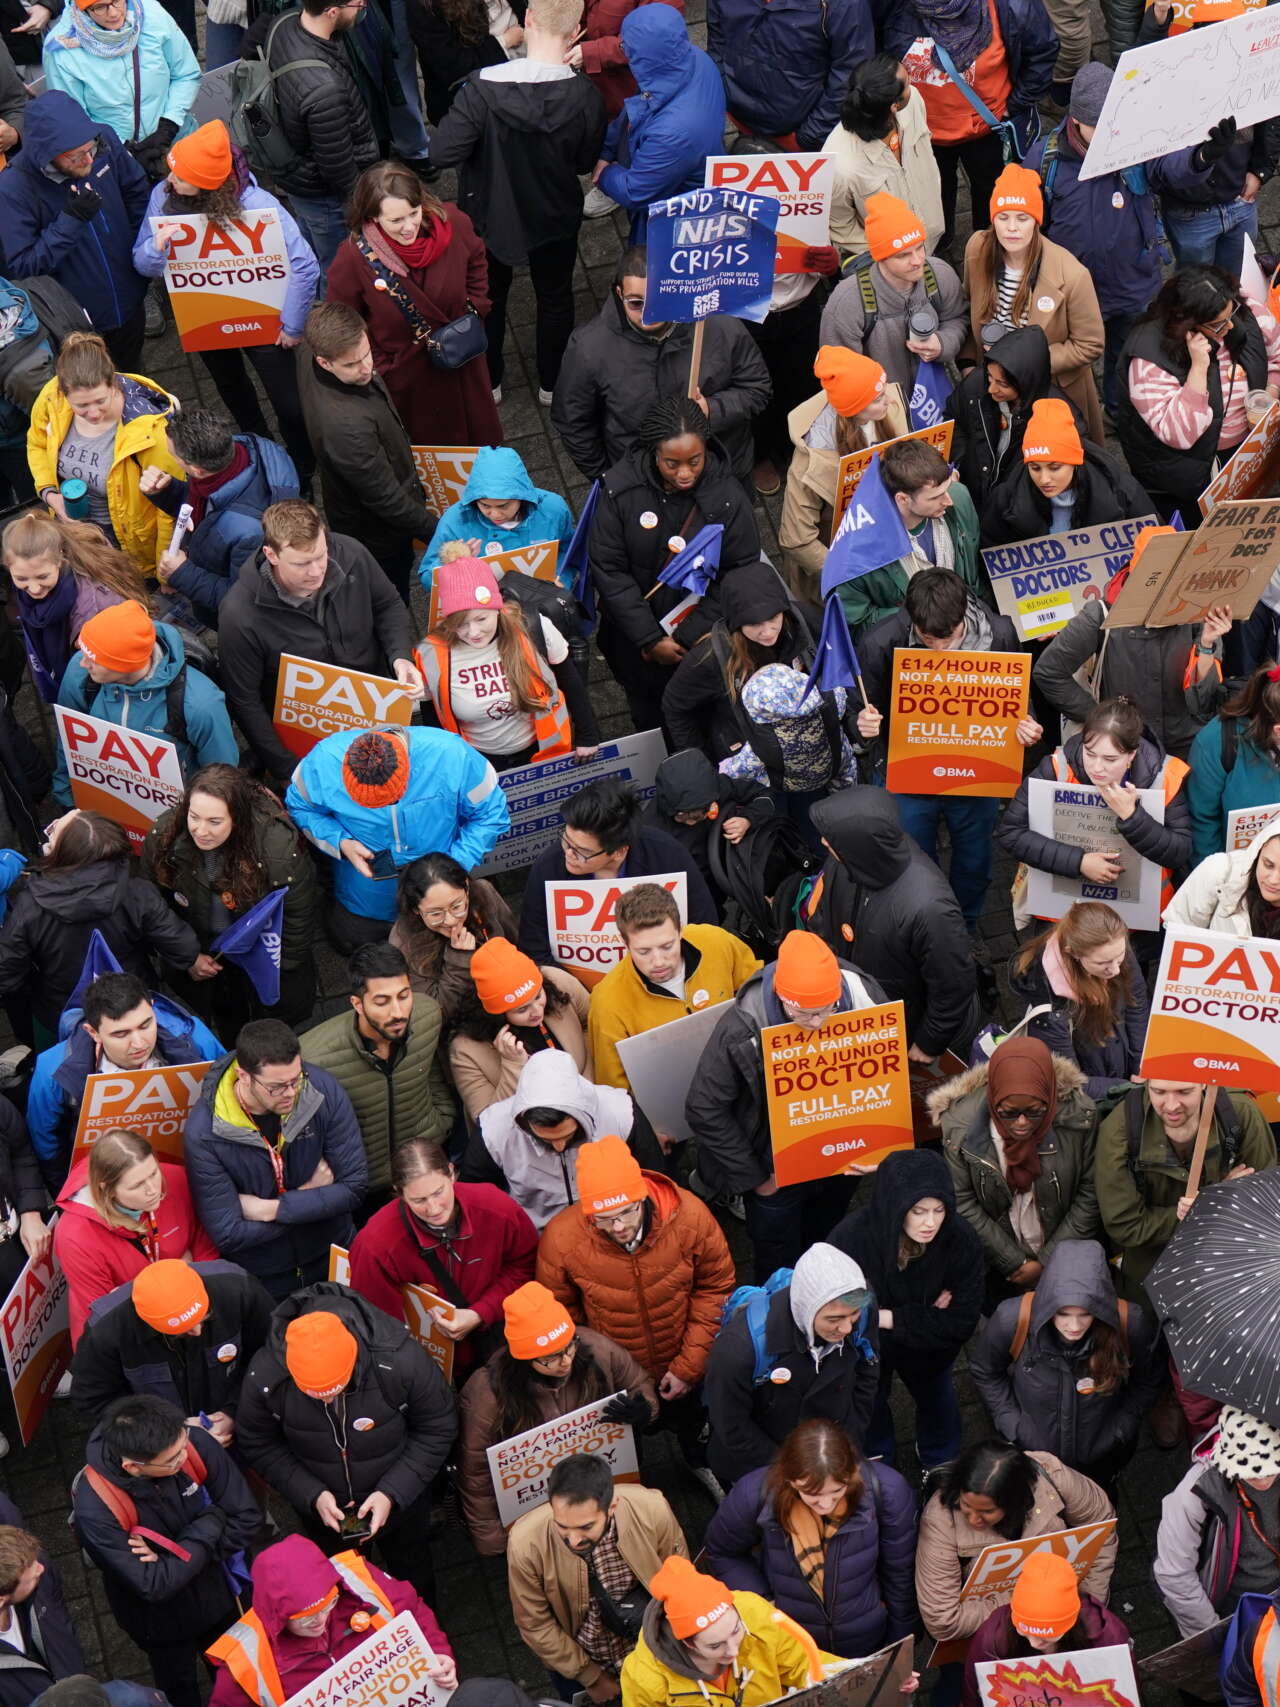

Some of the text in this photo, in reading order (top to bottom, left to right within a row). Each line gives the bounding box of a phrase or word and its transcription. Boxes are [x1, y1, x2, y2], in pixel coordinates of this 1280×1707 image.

[712, 159, 828, 193] PAY
[667, 192, 713, 217] END
[801, 193, 825, 201] FOR
[1006, 196, 1026, 205] BMA
[158, 218, 268, 260] PAY
[677, 214, 746, 245] NHS
[902, 229, 922, 243] BMA
[257, 255, 282, 265] FOR
[670, 244, 750, 275] CRISIS
[172, 265, 287, 288] DOCTORS
[660, 277, 760, 294] NHS KILLS
[1206, 505, 1261, 528] FAIR
[1243, 526, 1277, 541] FOR
[983, 533, 1091, 577] REDUCED TO
[1230, 542, 1273, 559] DOCS
[1011, 562, 1093, 599] DOCTORS
[1184, 568, 1246, 592] HONK
[901, 658, 1023, 674] £14/HOUR IS
[899, 671, 1023, 687] NOT FAIR WAGE
[283, 661, 407, 722] PAY
[899, 683, 1022, 700] FOR JUNIOR
[282, 697, 373, 728] RESTORATION
[898, 696, 1020, 719] DOCTOR
[908, 721, 1009, 740] FULL PAY
[62, 713, 168, 779] PAY
[907, 736, 1007, 748] RESTORATION NOW
[73, 761, 180, 808] DOCTORS
[947, 769, 977, 778] BMA
[1055, 789, 1108, 808] BARCLAYS
[501, 818, 559, 845] NHS IS
[1235, 821, 1265, 832] NOT
[494, 846, 528, 861] LOOK
[1083, 886, 1115, 899] NHS
[514, 979, 537, 998] BMA
[1164, 983, 1267, 1005] RESTORATION
[771, 1012, 898, 1049] £14/HOUR IS
[771, 1027, 898, 1062] NOT FAIR WAGE
[773, 1039, 900, 1076] FOR JUNIOR
[1208, 1060, 1240, 1072] BMA
[774, 1053, 901, 1097] DOCTOR
[88, 1071, 205, 1117] PAY
[788, 1083, 893, 1118] FULL PAY
[87, 1109, 185, 1127] RESTORATION
[789, 1098, 892, 1127] RESTORATION NOW
[604, 1193, 629, 1206] BMA
[180, 1301, 203, 1322] BMA
[548, 1321, 569, 1341] BMA
[496, 1410, 599, 1459] £14/HOUR
[498, 1430, 578, 1468] NOT FAIR
[499, 1456, 537, 1477] FOR
[707, 1601, 729, 1622] BMA
[390, 1624, 410, 1643] IS
[343, 1635, 416, 1695] FAIR WAGE
